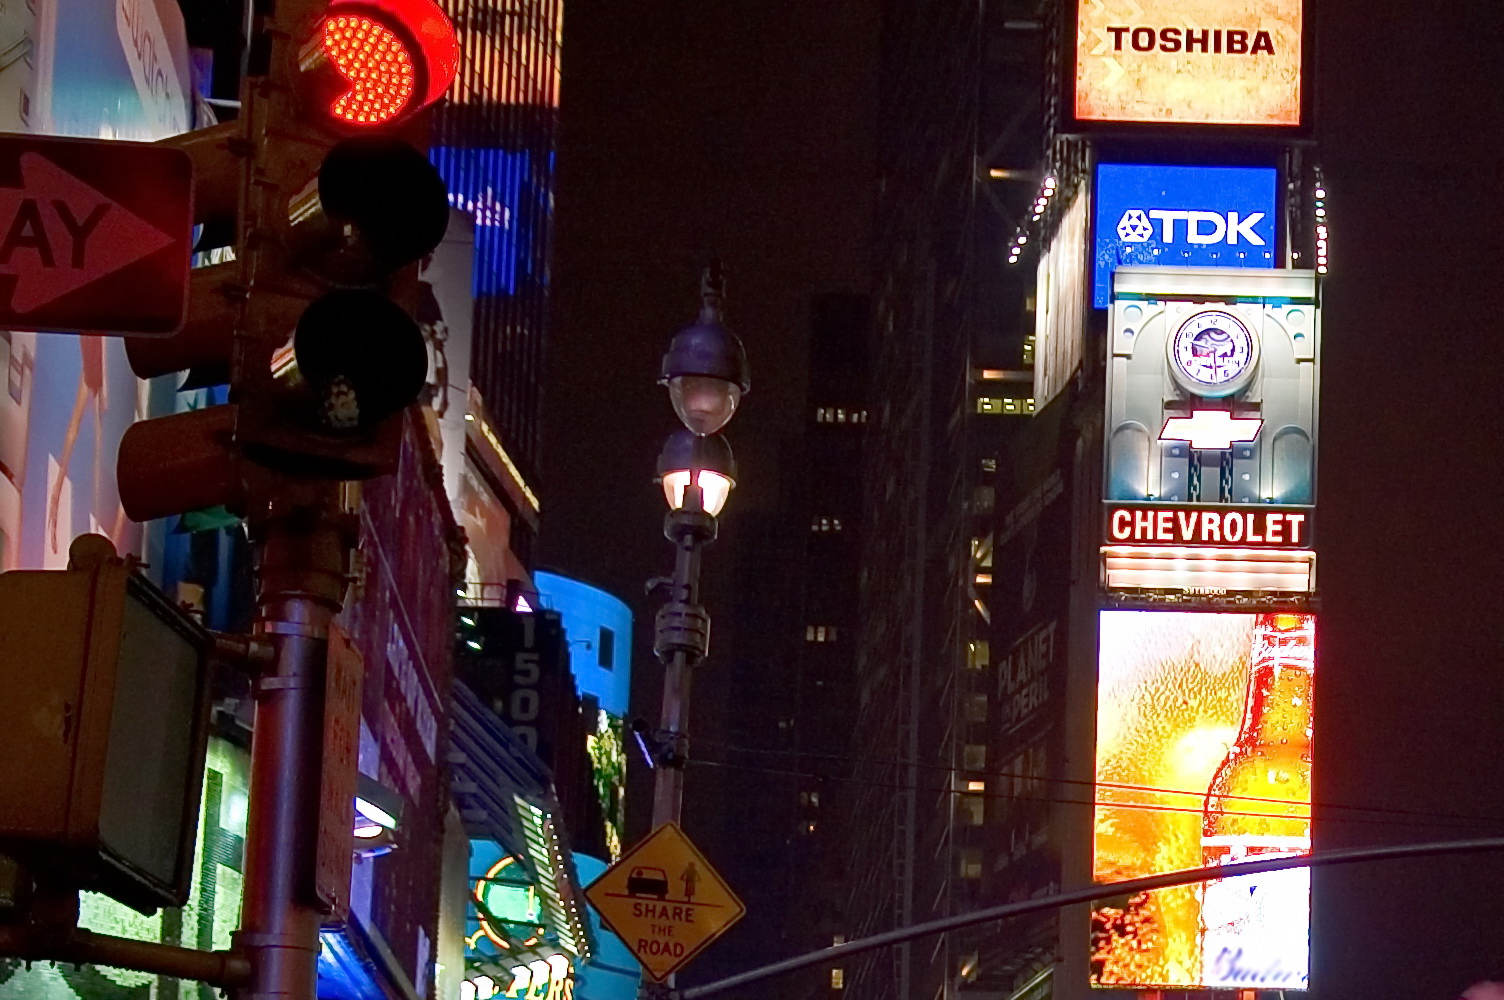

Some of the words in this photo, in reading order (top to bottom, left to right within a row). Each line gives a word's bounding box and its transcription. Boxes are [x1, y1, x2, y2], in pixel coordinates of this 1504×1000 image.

[1106, 26, 1276, 56] TOSHIBA
[1148, 209, 1266, 246] TDK
[1112, 510, 1305, 543] CHEVROLET
[632, 902, 695, 923] SHARE
[651, 924, 675, 937] THE
[637, 938, 685, 958] ROAD
